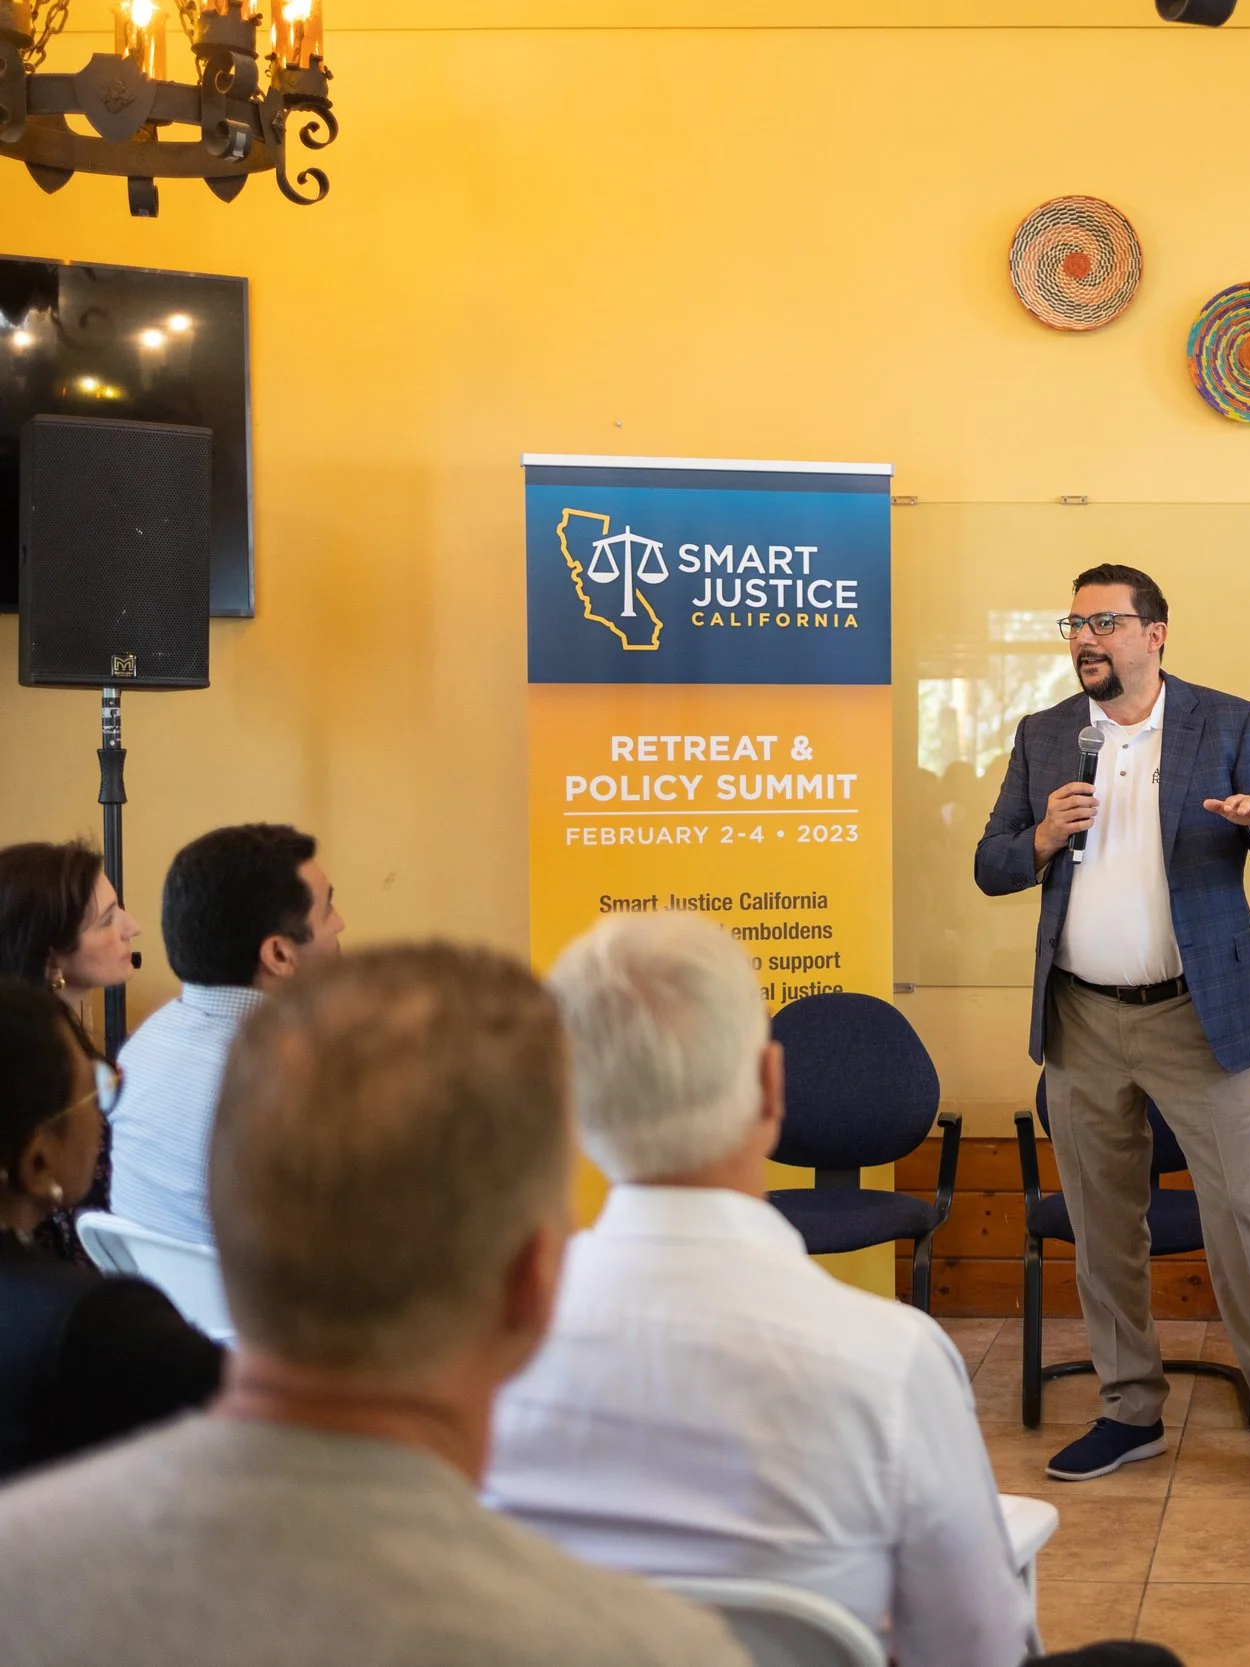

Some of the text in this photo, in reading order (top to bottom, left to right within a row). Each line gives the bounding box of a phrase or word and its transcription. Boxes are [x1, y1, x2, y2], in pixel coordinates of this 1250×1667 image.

[678, 543, 819, 575] SMART
[692, 577, 858, 609] JUSTICE
[691, 611, 858, 628] CALIFORNIA
[611, 735, 814, 762] RETREAT &
[566, 773, 858, 801] POLICY SUMMIT
[566, 824, 859, 845] FEBRUARY 2-4 2023
[600, 891, 828, 913] Smart Justice California
[731, 921, 833, 941] emboldens
[768, 951, 842, 974] support
